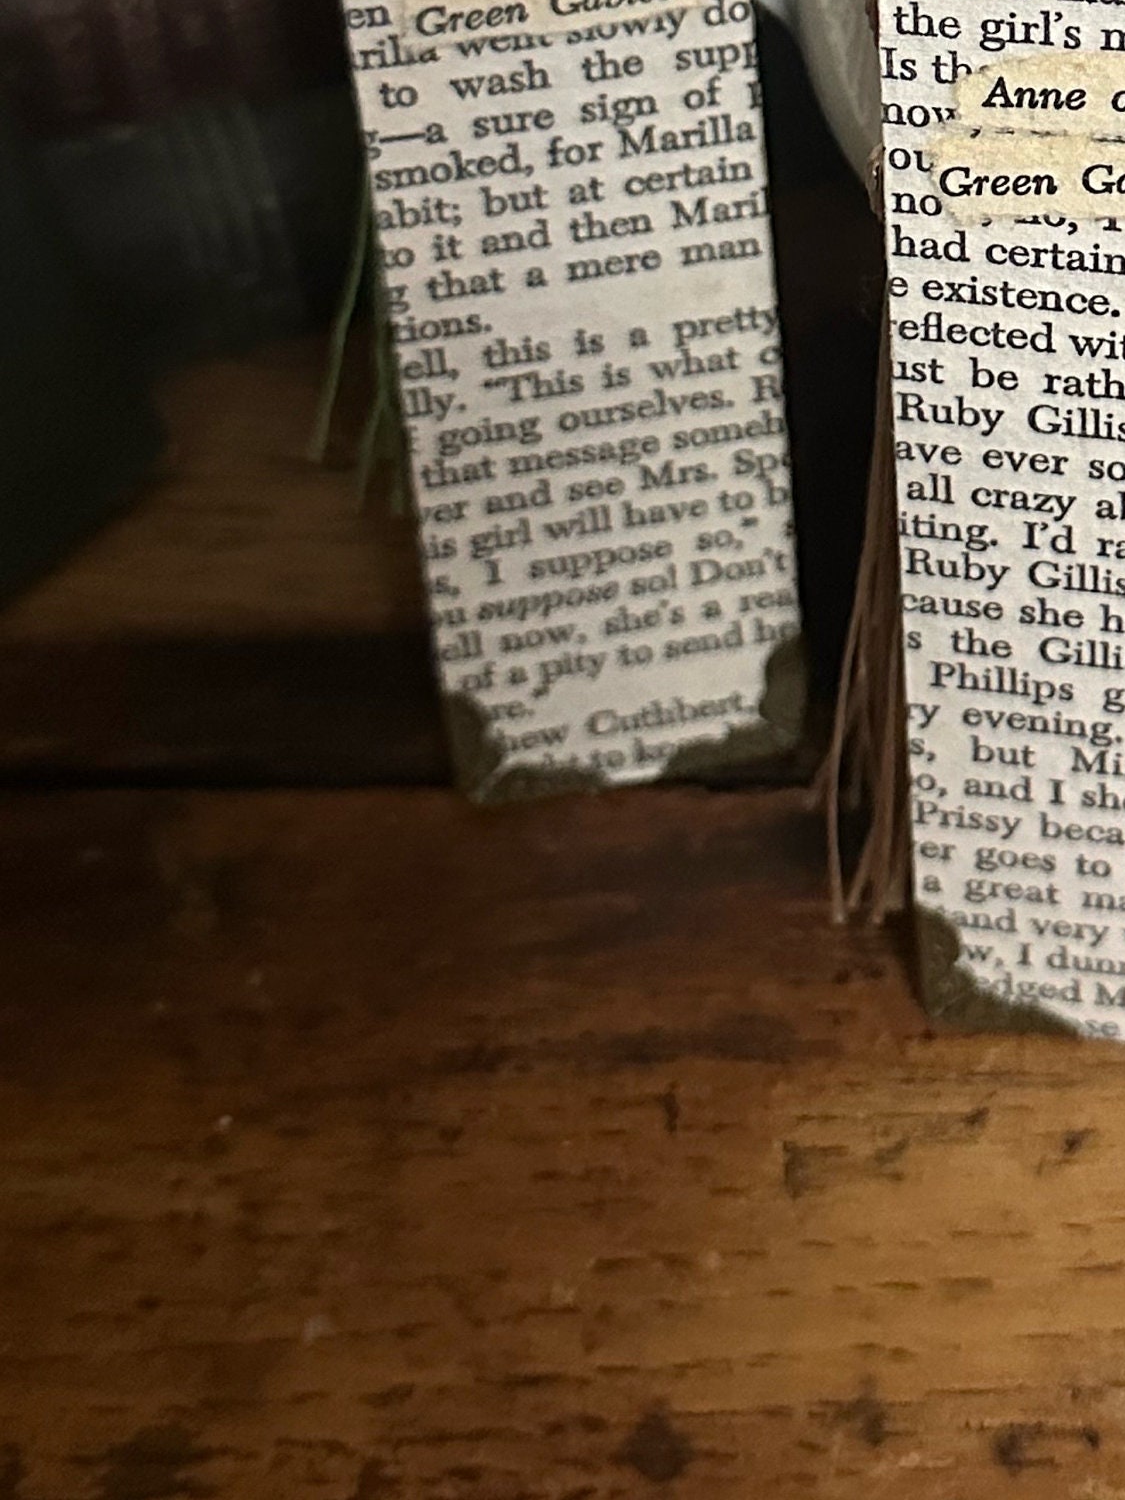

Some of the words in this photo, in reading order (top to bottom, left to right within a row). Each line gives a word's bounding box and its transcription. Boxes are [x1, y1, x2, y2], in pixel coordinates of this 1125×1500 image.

[414, 2, 529, 37] Green
[892, 0, 962, 40] the
[378, 82, 419, 110] to
[448, 59, 552, 100] wash
[580, 49, 644, 84] the
[980, 75, 1087, 111] Anne
[472, 108, 555, 139] sure
[580, 92, 660, 130] sign
[374, 150, 536, 192] smoked,
[546, 135, 604, 169] for
[618, 116, 756, 160] Marilla
[623, 156, 753, 197] certain
[938, 166, 1058, 198] Green
[568, 211, 654, 244] then
[892, 223, 971, 263] had
[425, 268, 505, 302] that
[566, 250, 661, 283] mere
[921, 279, 1121, 319] existence.
[651, 346, 741, 384] what
[438, 416, 543, 457] going
[557, 388, 734, 433] ourselves.
[897, 391, 1005, 438] Ruby
[420, 461, 496, 489] that
[508, 436, 660, 477] message
[567, 478, 624, 503] see
[639, 459, 720, 491] Mrs.
[981, 449, 1070, 477] ever
[970, 487, 1078, 523] crazy
[470, 520, 533, 561] girl
[1018, 596, 1085, 630] she
[929, 660, 1074, 708] Phillips
[961, 708, 1123, 749] evening.
[964, 880, 1059, 906] great
